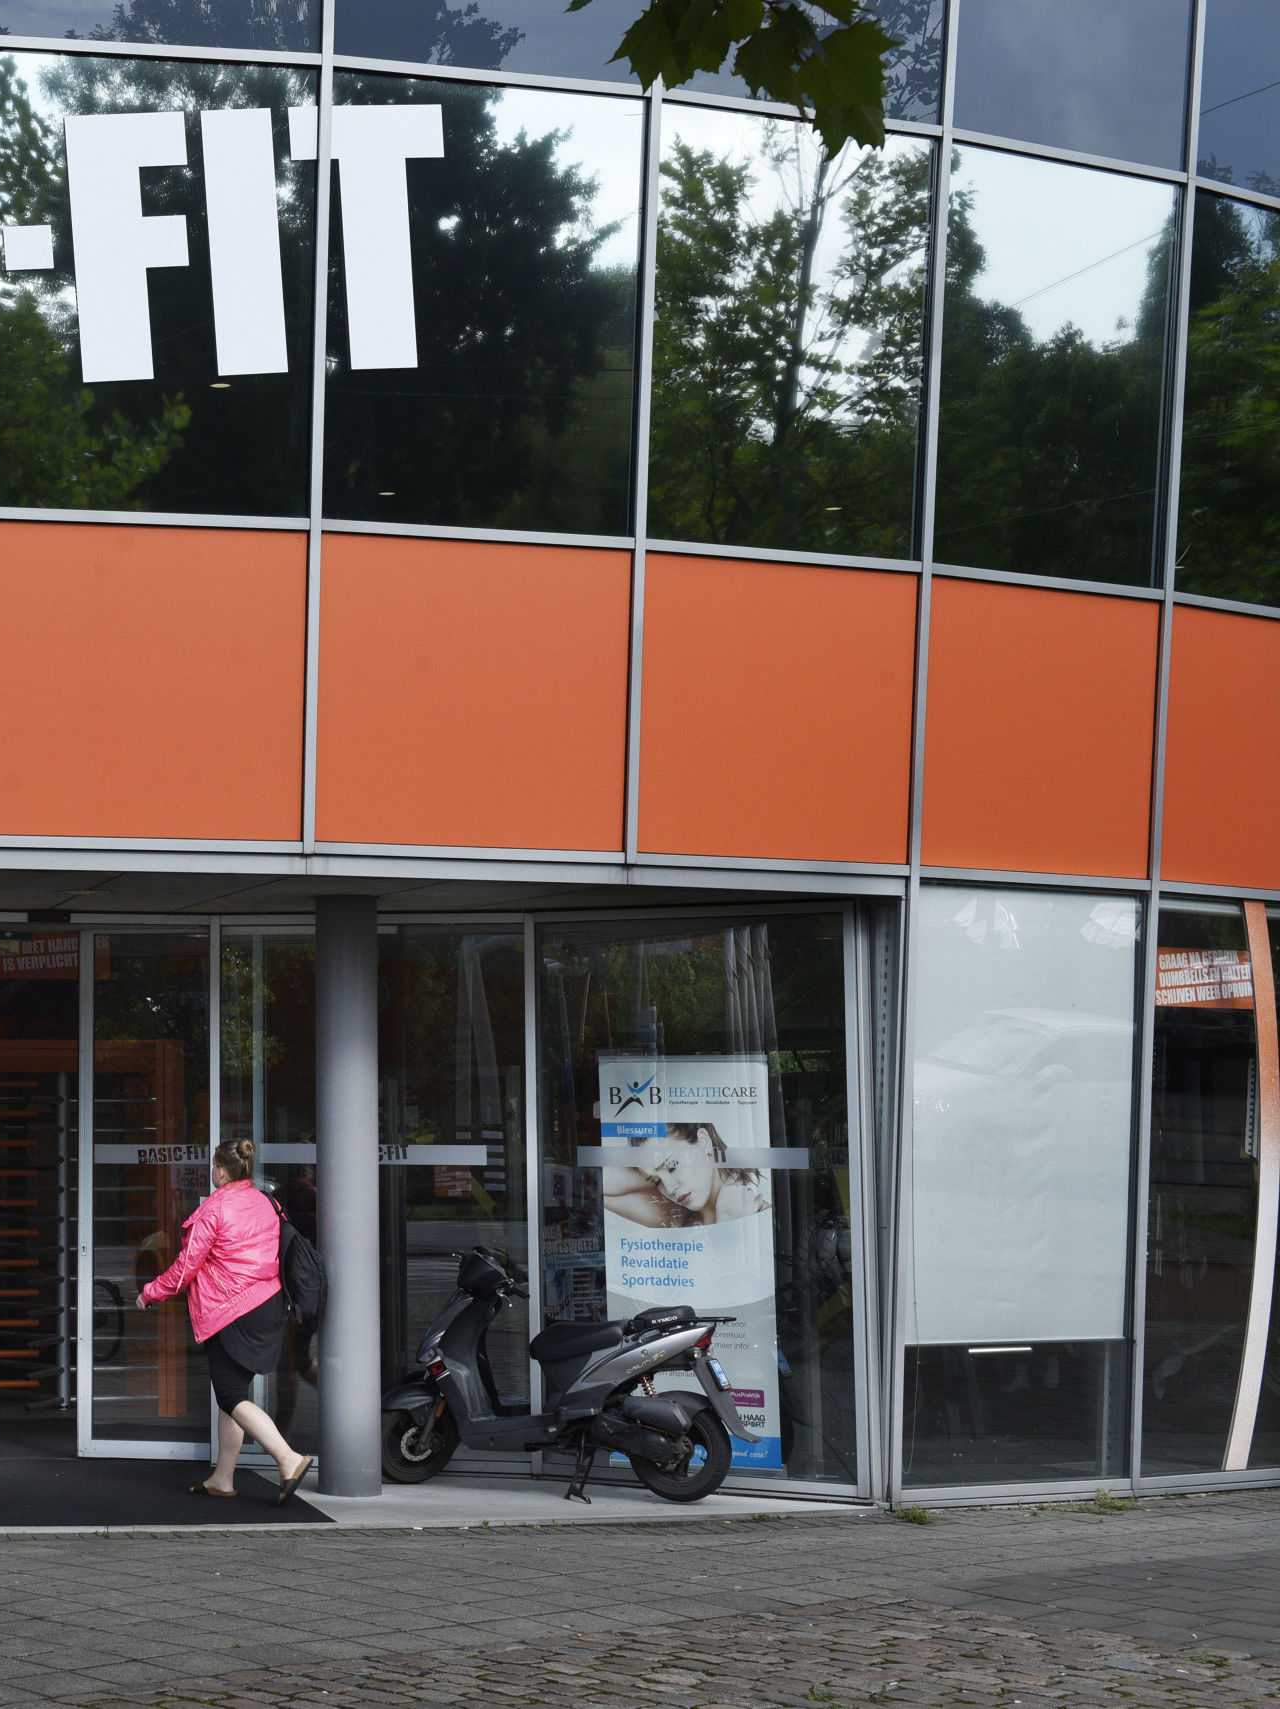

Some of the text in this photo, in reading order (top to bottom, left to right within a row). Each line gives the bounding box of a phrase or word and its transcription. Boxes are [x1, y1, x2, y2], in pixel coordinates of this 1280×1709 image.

[1159, 952, 1188, 970] GRAAG
[1159, 967, 1209, 988] DUMBBELLS
[1156, 987, 1196, 1006] SCHIJVEN
[1196, 984, 1221, 1002] WEER
[669, 1086, 758, 1098] HEALTHCARE
[617, 1125, 658, 1136] Blessure?
[137, 1144, 208, 1163] BASIC-FIT
[620, 1238, 703, 1252] Fysiotherapie
[621, 1256, 689, 1270] Revalidatie
[622, 1274, 695, 1288] Sportadvies
[651, 1315, 678, 1325] KYMCO
[743, 1414, 766, 1422] HAAG
